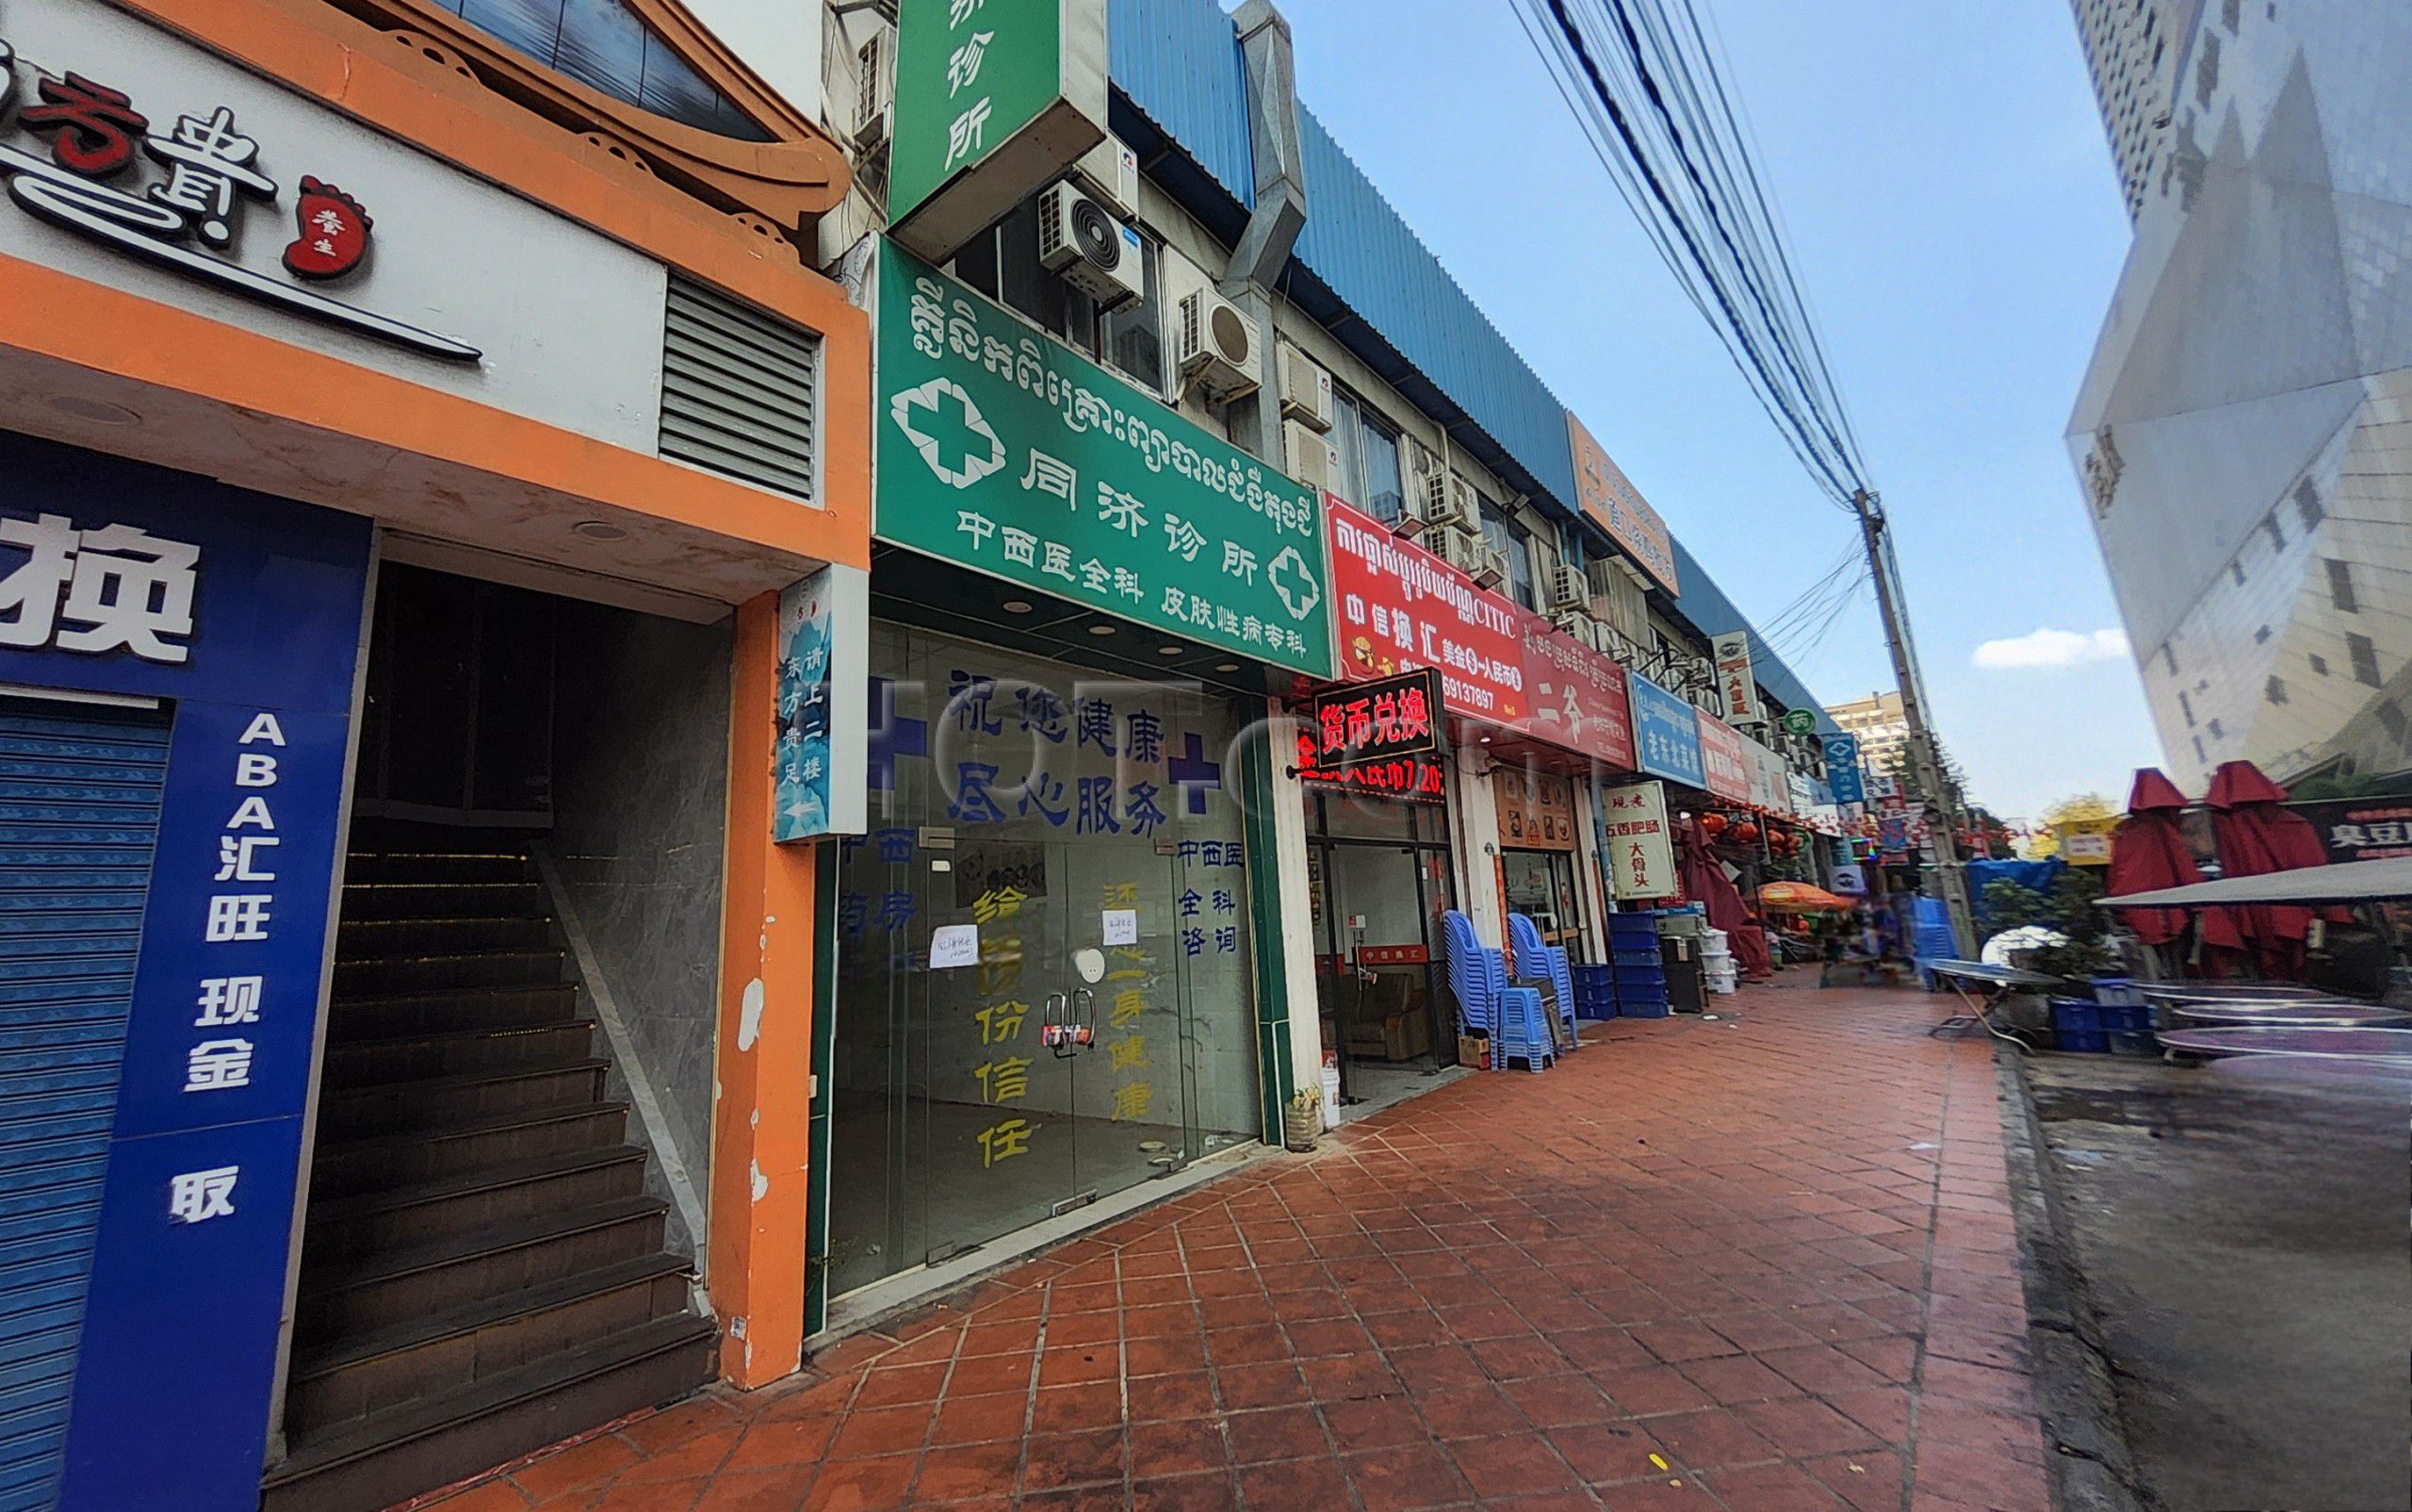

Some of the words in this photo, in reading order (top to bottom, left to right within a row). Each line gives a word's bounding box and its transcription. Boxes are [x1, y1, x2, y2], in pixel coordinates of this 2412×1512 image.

[1019, 447, 1259, 587] 同济诊所
[0, 512, 202, 663] 换
[955, 510, 1145, 605] 中西医全科
[1160, 586, 1308, 659] 皮肤性病专科
[1473, 597, 1517, 640] CITIC
[1345, 593, 1442, 662] 中信换汇
[947, 670, 1165, 765] 祝您健康
[1320, 687, 1429, 755] 货币兑换
[947, 762, 1168, 837] 尽心服务
[1178, 888, 1236, 917] 全科
[1182, 925, 1237, 958] 咨询
